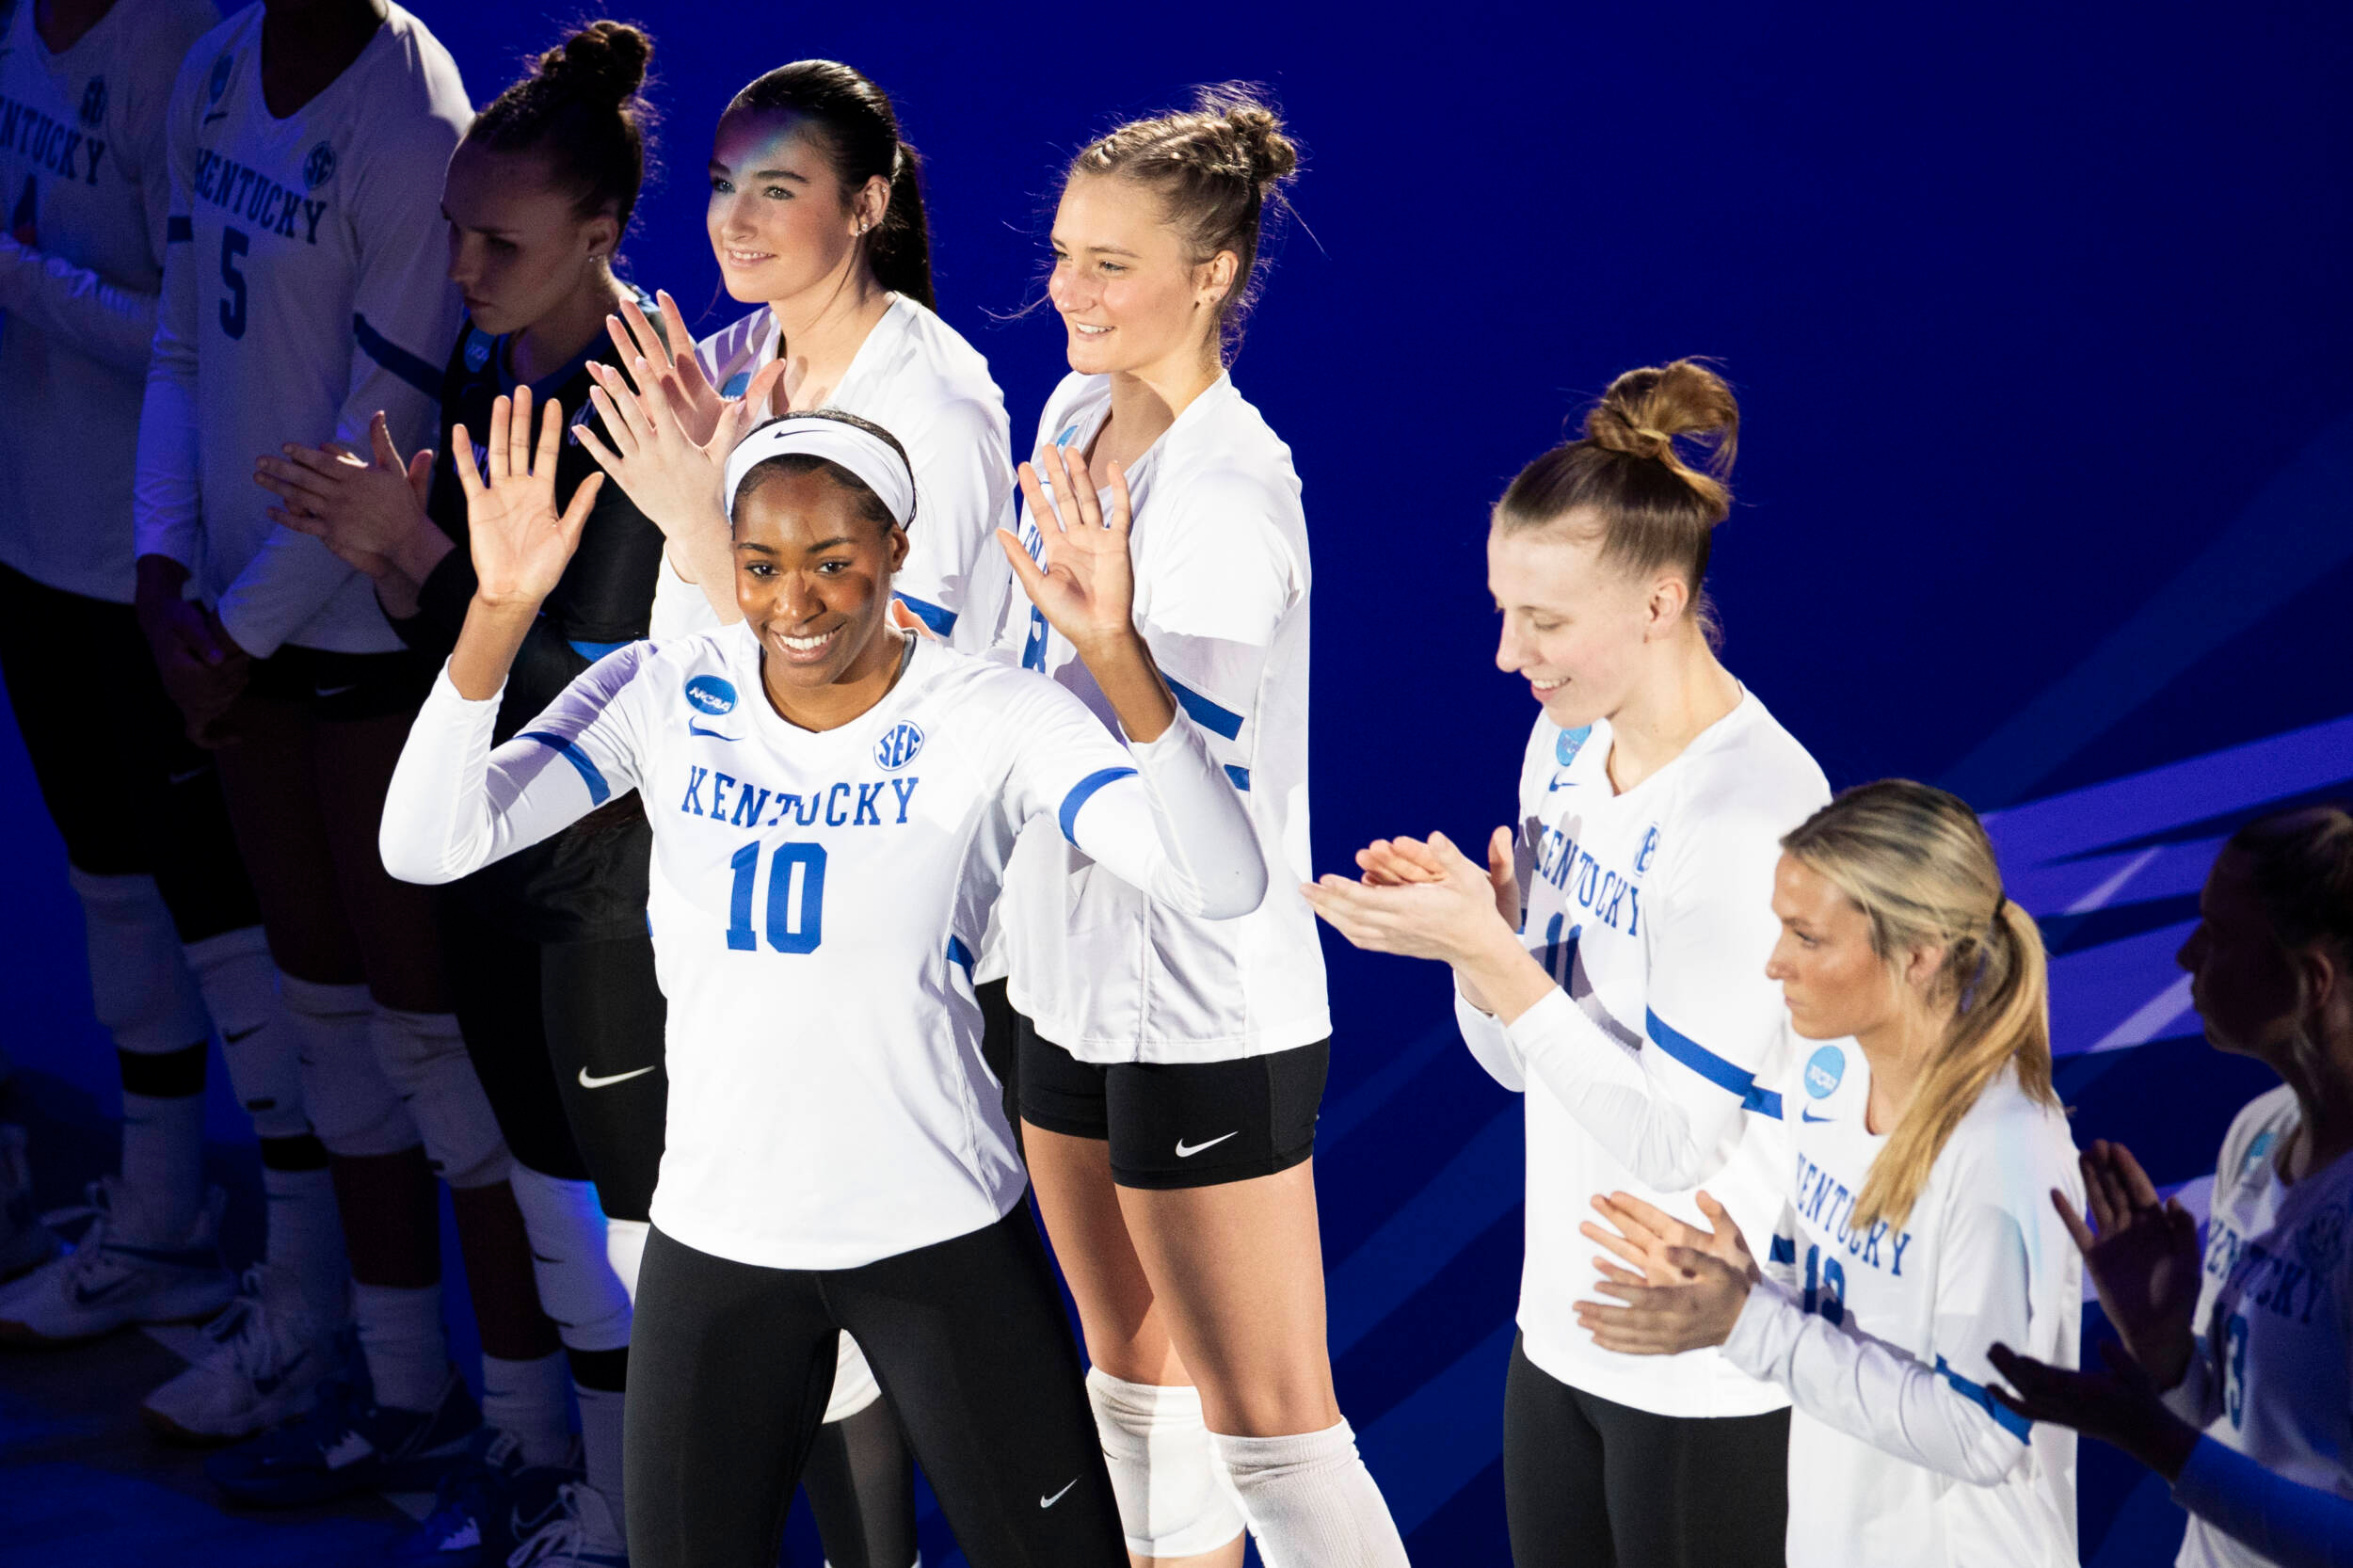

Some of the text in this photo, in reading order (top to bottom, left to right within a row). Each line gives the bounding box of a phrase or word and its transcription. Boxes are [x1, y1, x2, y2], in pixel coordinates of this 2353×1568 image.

[219, 225, 249, 341] 5
[878, 724, 920, 768] SEC
[681, 765, 919, 827] KENTUCKY
[726, 840, 827, 954] 10
